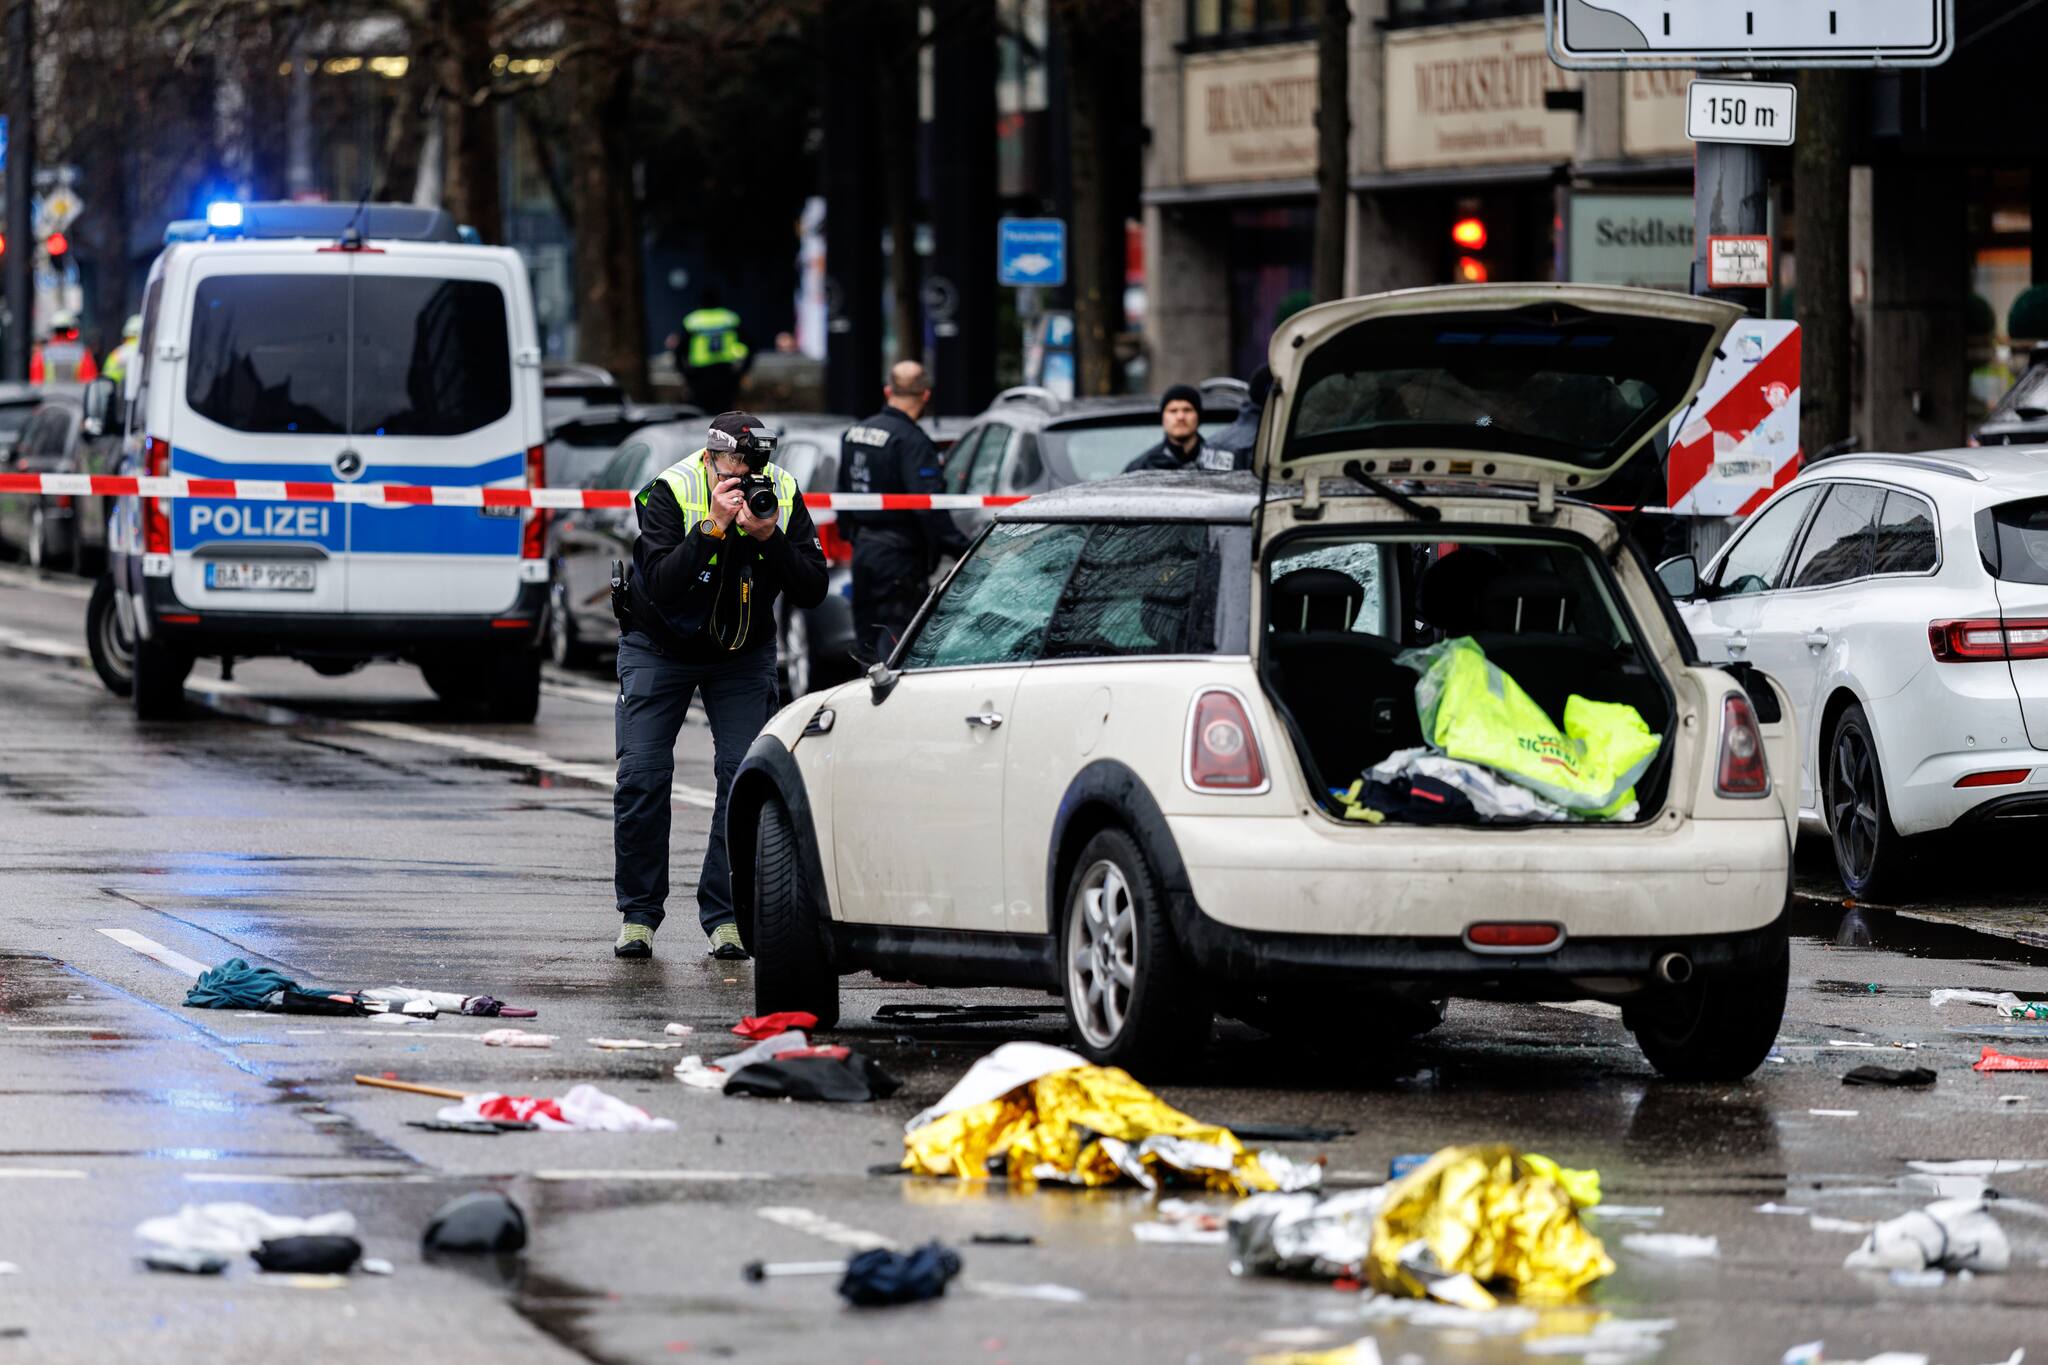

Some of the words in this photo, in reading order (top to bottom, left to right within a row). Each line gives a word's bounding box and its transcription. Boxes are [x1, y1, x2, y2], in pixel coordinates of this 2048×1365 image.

[1707, 96, 1747, 126] 150
[1754, 106, 1776, 128] m
[189, 505, 330, 537] POLIZEI
